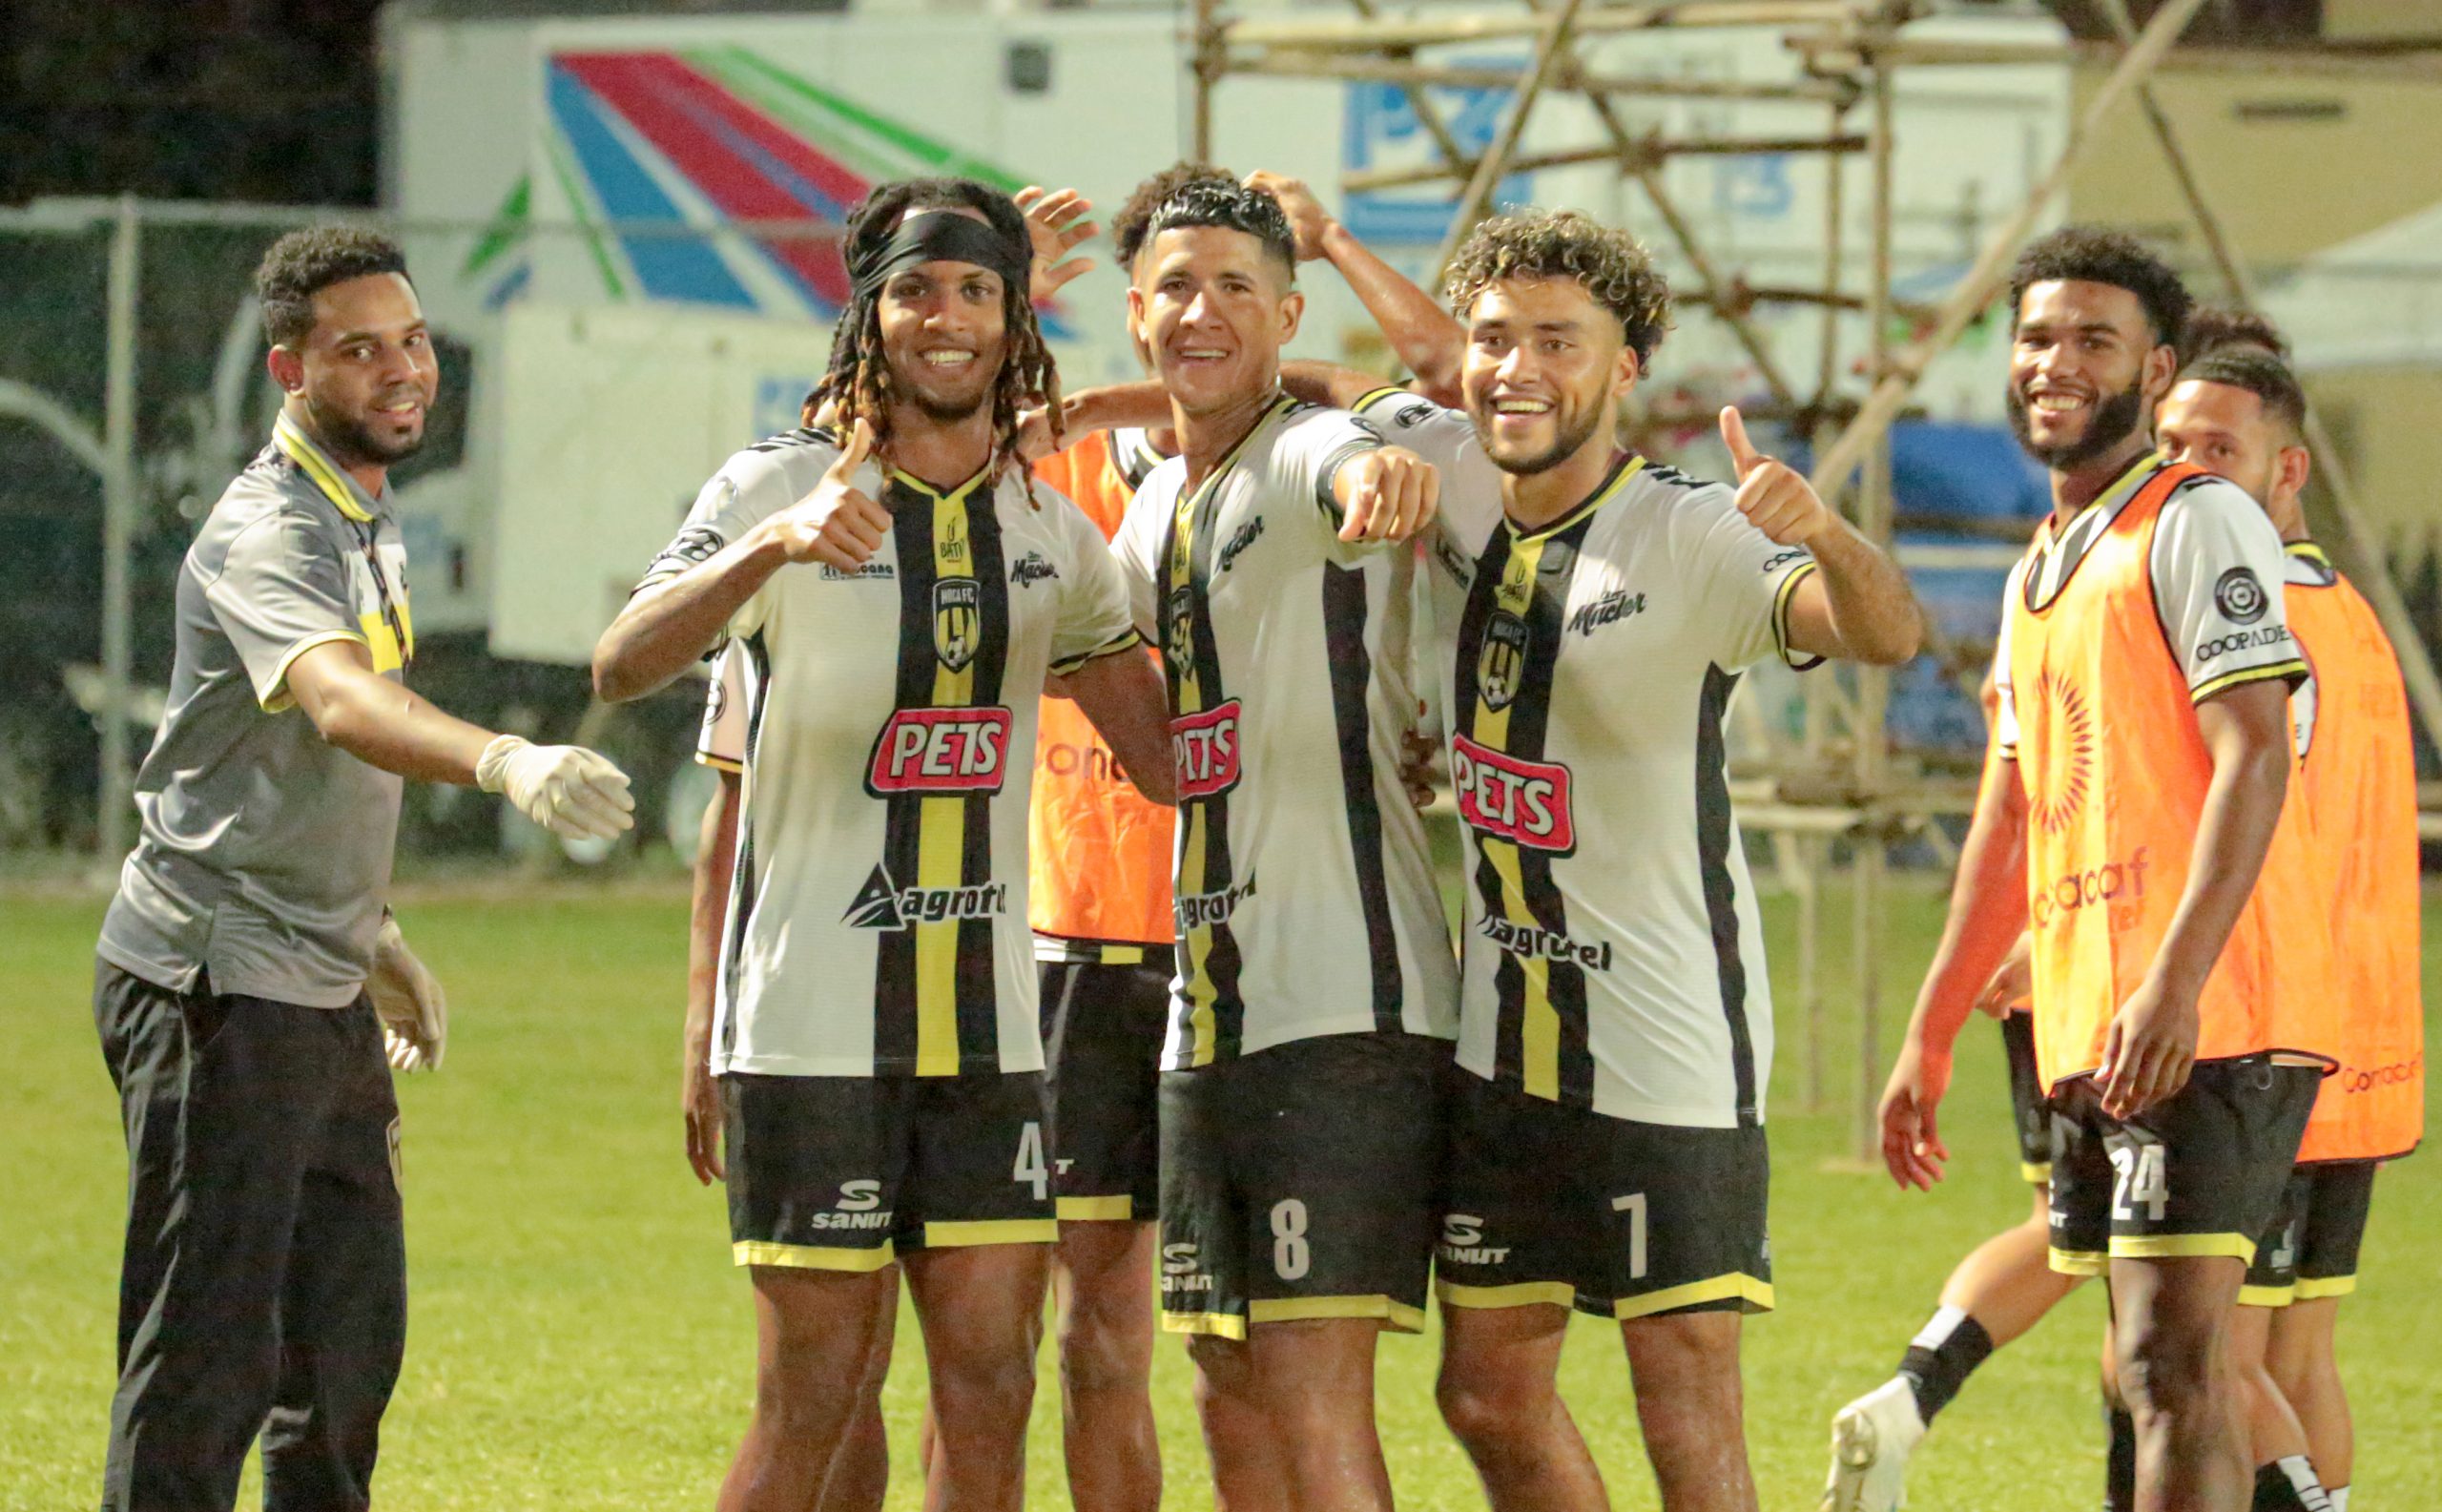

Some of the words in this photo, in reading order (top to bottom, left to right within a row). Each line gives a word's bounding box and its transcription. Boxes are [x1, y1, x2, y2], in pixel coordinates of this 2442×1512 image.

[889, 720, 1003, 777] PETS
[1455, 750, 1554, 836] PETS
[1013, 1122, 1048, 1200] 4
[2109, 1145, 2169, 1220] 24
[1271, 1199, 1311, 1280] 8
